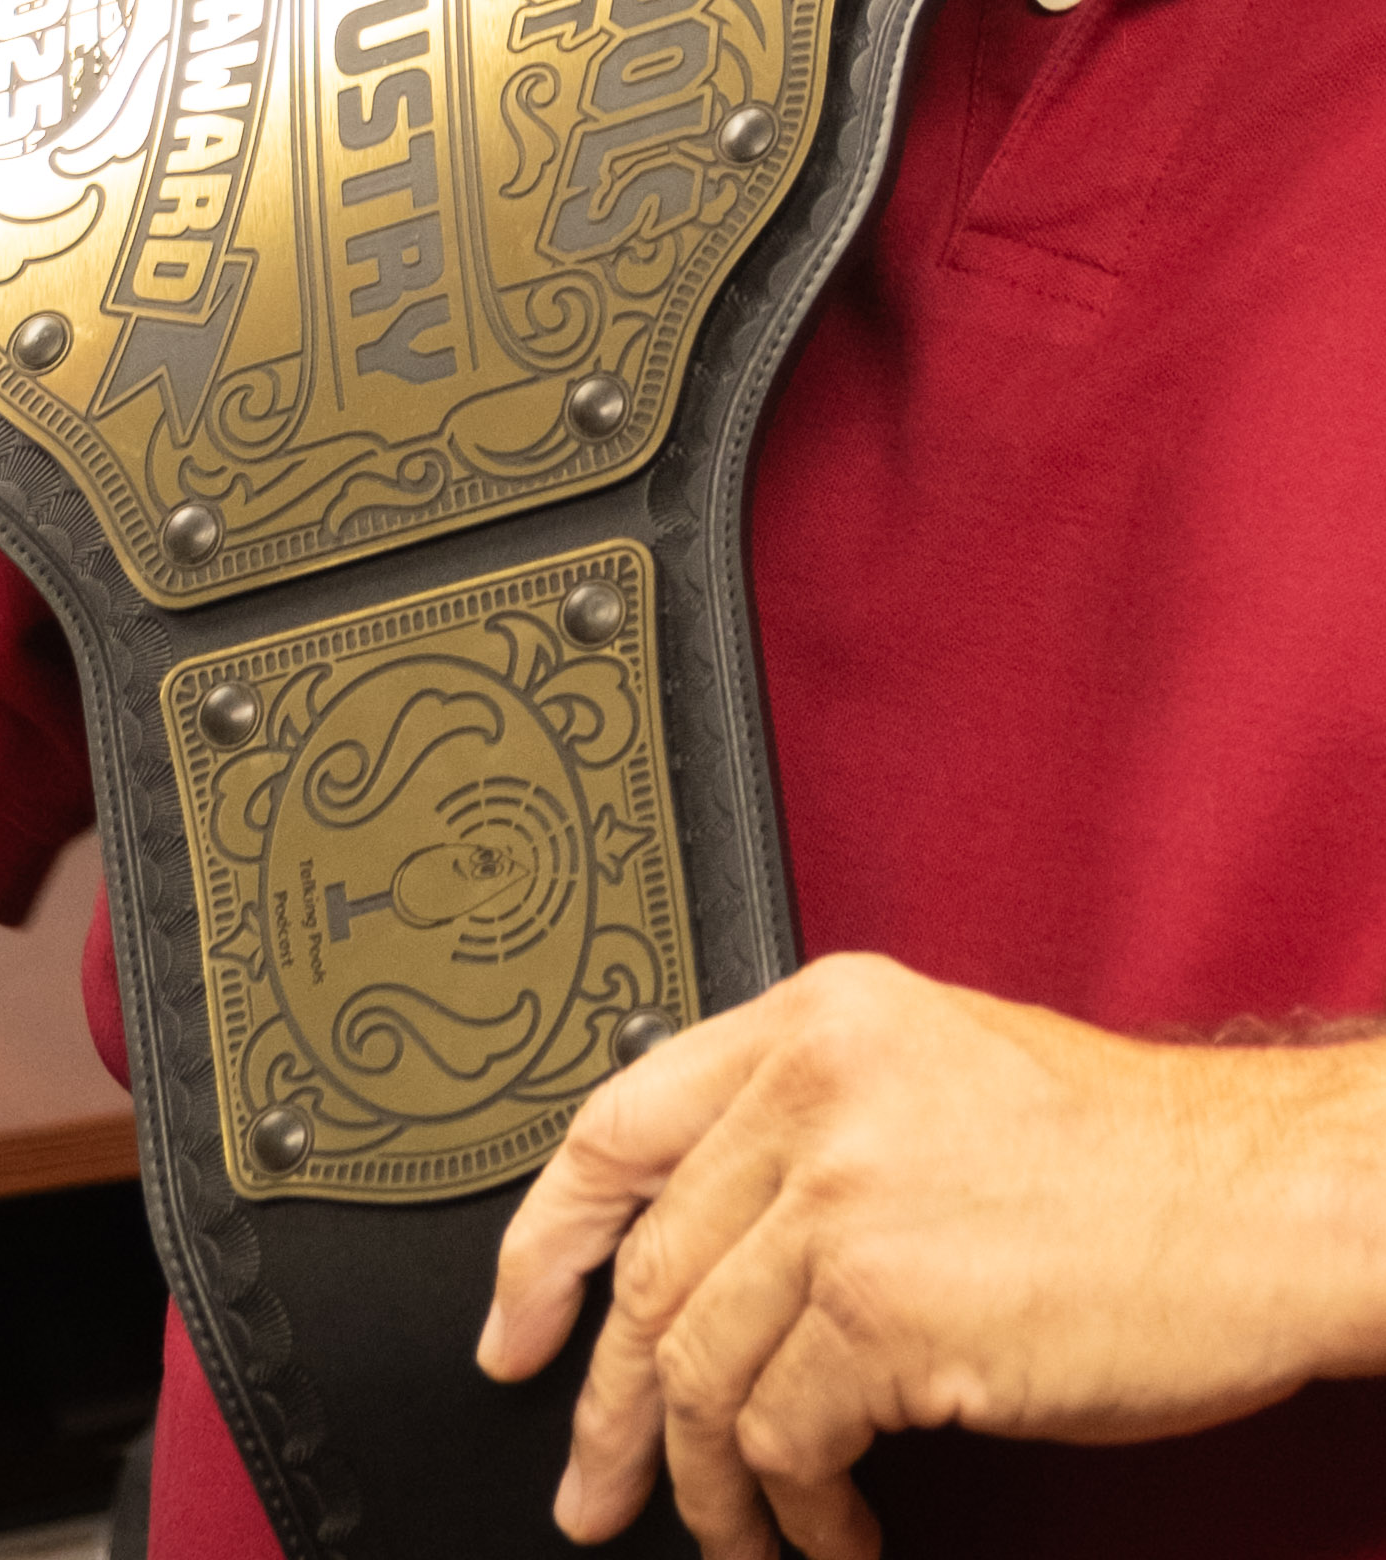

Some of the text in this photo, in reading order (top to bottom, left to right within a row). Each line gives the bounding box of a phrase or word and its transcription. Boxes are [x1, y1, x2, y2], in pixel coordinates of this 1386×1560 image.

[272, 889, 295, 969] Podcast
[298, 858, 326, 985] Talking Pools
